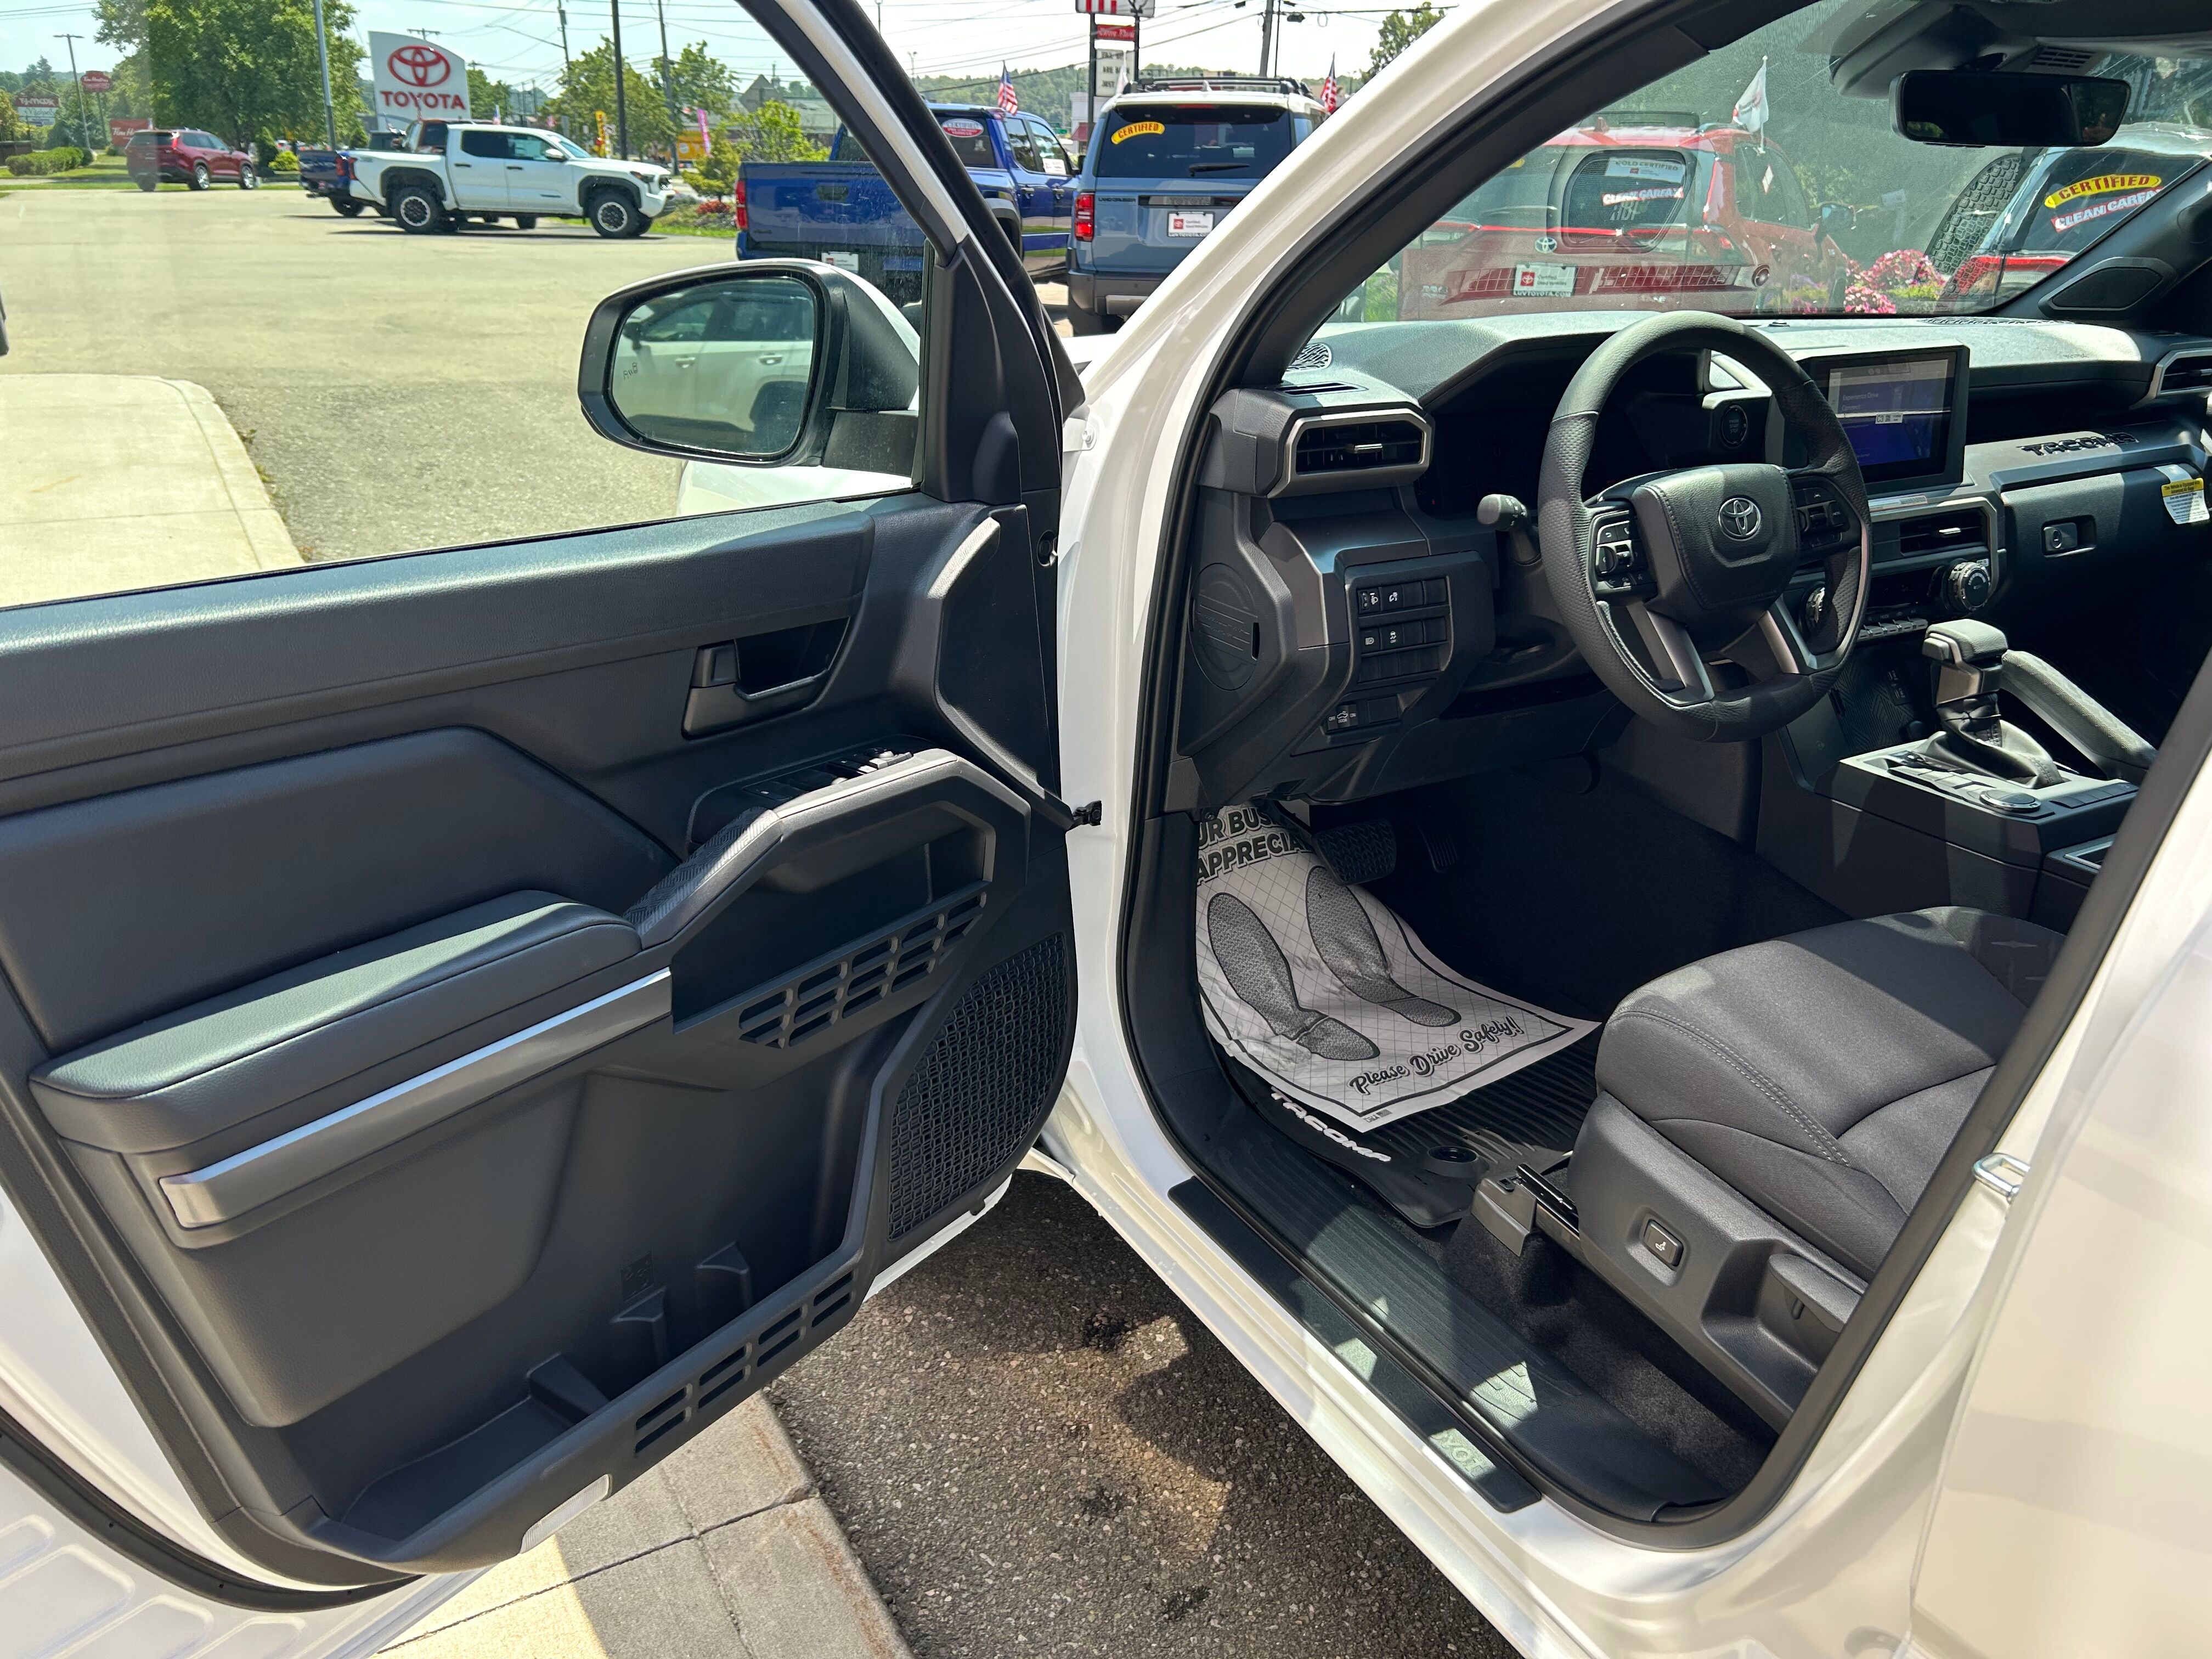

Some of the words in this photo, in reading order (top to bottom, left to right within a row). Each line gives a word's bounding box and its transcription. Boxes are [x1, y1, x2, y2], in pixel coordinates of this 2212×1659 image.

[380, 90, 466, 110] TOYOTA
[1118, 123, 1159, 138] CERTIFIED
[1639, 162, 1678, 171] CERTIFIED
[1603, 192, 1637, 205] CLEAN
[2058, 177, 2149, 199] CERTIFIED
[1169, 196, 1211, 205] TOYOTA
[2055, 205, 2107, 229] CLEAN
[2107, 189, 2162, 211] CARFA
[2017, 432, 2139, 456] TACOMA
[1227, 808, 1273, 836] BUS
[1198, 832, 1308, 881] APPRECIA
[1348, 1064, 1409, 1096] Please
[1408, 1043, 1462, 1077] Drive
[1271, 1086, 1391, 1162] TACOMA
